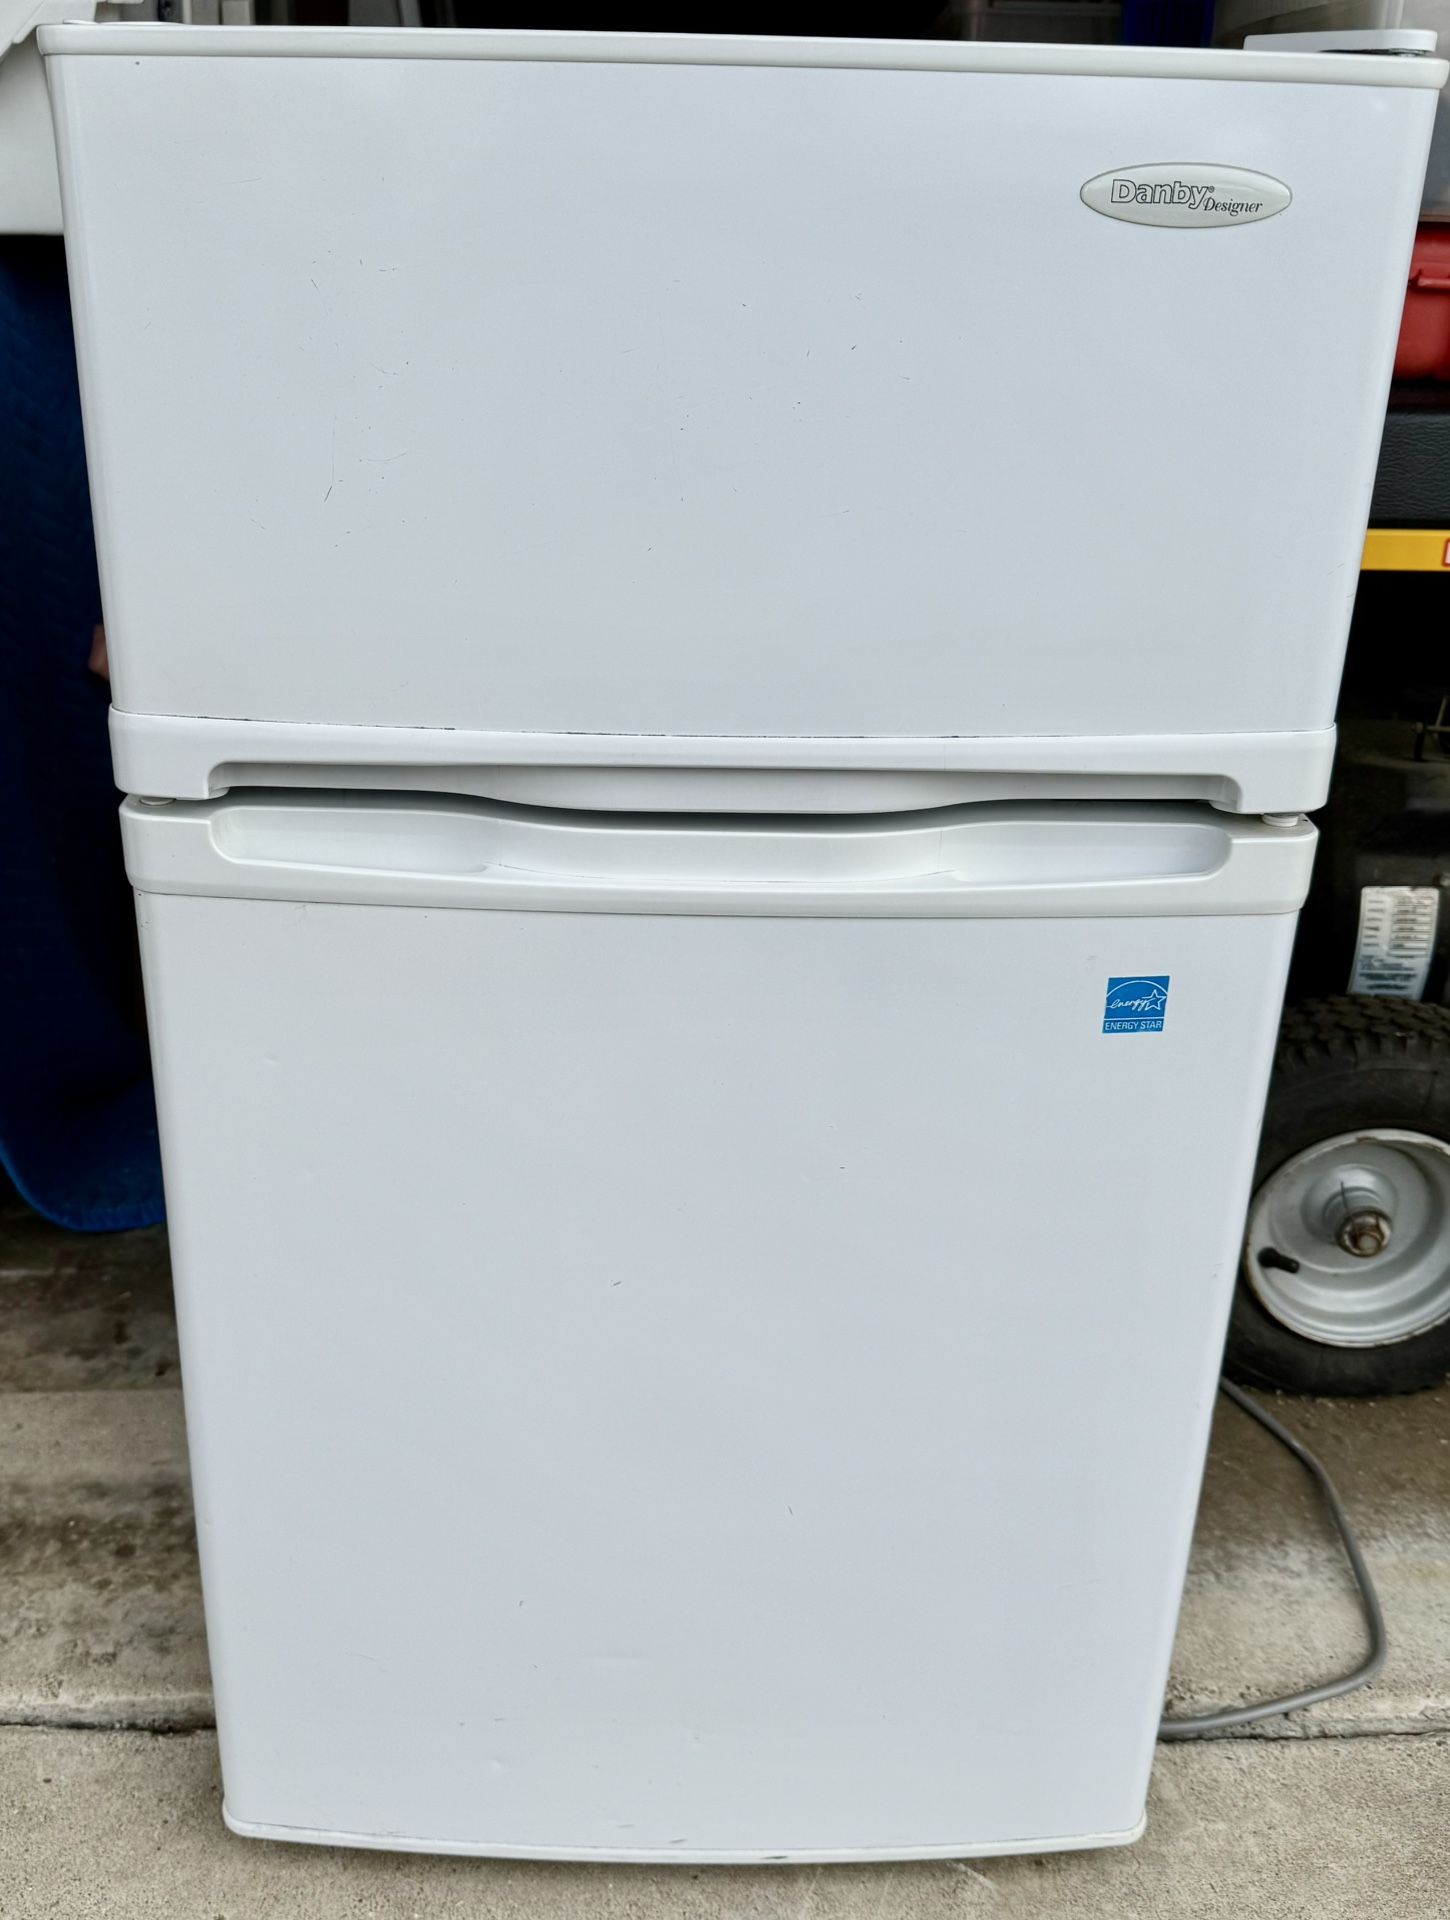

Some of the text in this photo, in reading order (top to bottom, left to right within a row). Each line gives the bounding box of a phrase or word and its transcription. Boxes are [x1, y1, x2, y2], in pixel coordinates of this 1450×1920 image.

[1203, 197, 1263, 216] Designer
[1105, 1020, 1162, 1031] ENERGY STAR
